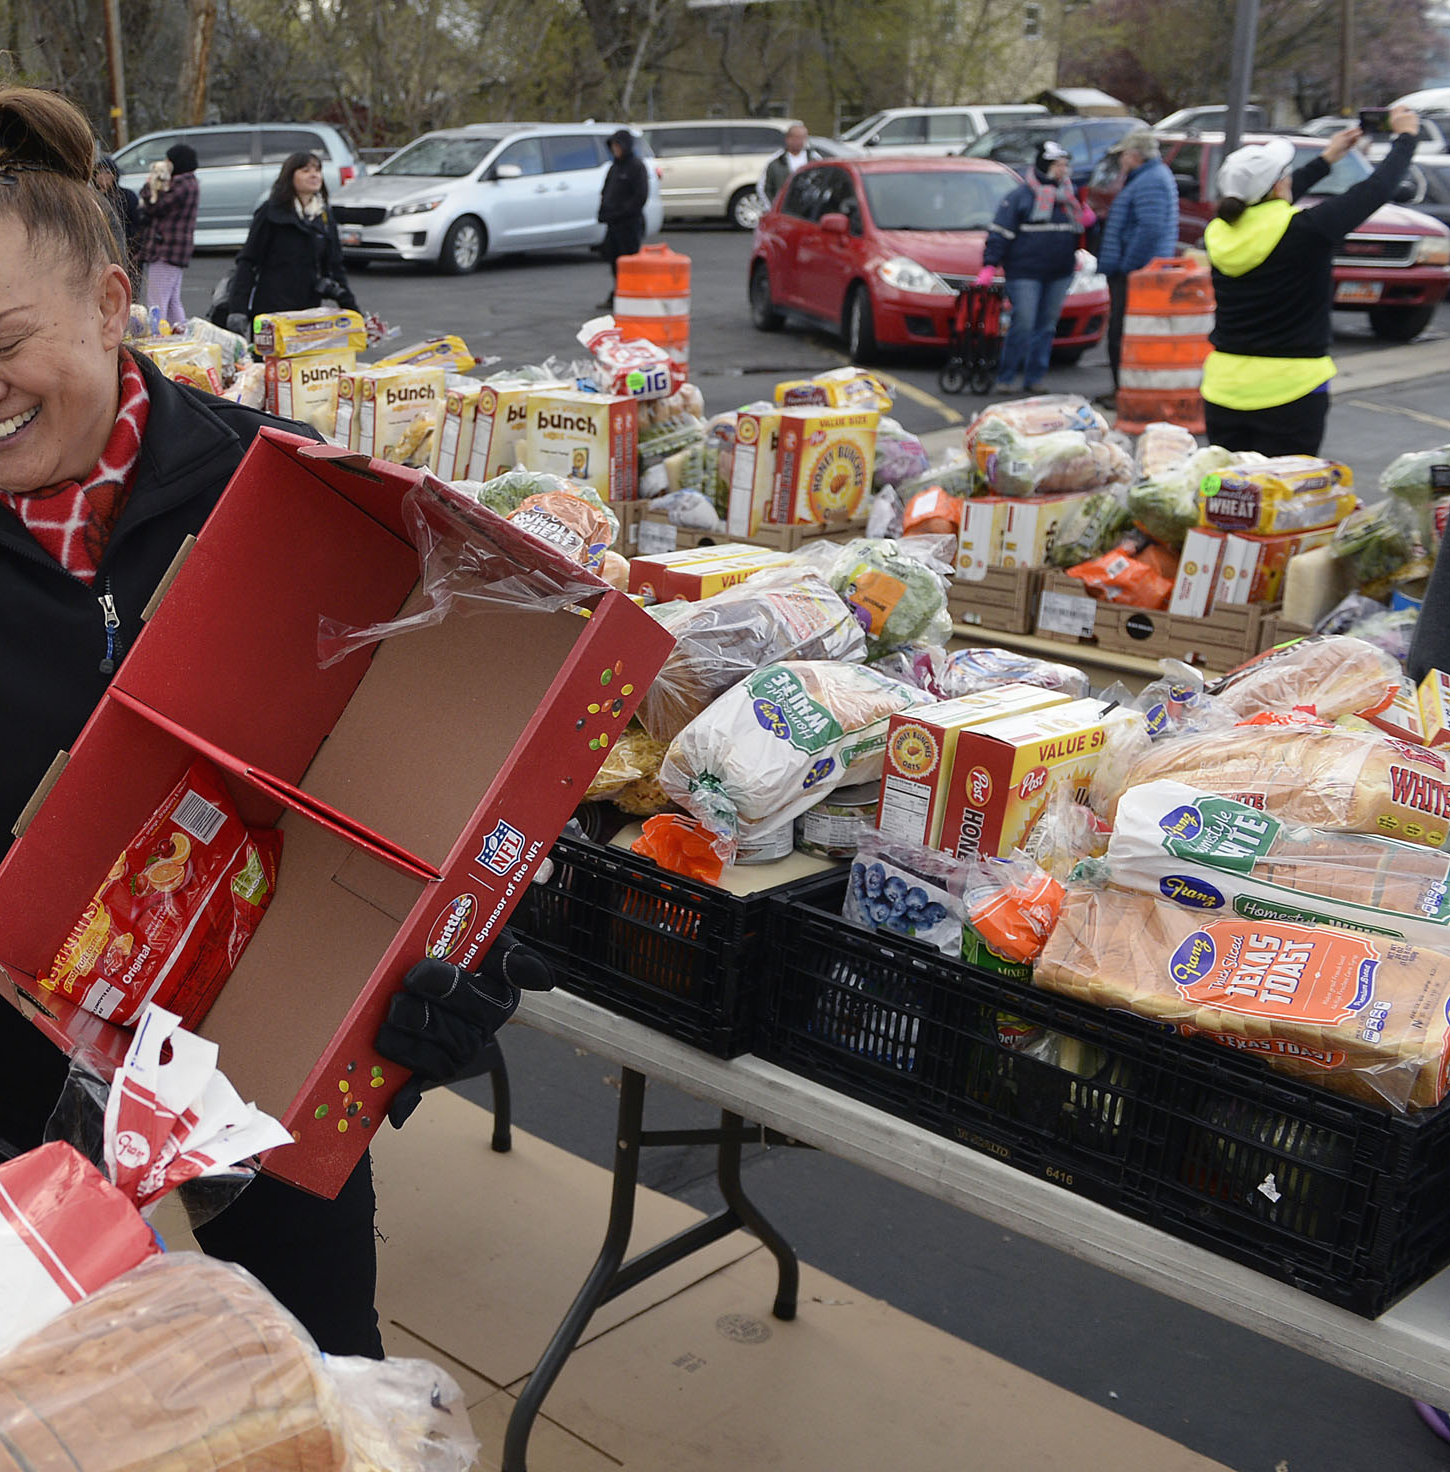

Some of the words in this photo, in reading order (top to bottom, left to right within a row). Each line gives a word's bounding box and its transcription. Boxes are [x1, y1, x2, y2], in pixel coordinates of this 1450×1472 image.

[301, 365, 347, 385] bunch
[386, 384, 436, 406] bunch
[537, 411, 598, 437] bunch
[1208, 497, 1256, 518] WHEAT
[510, 518, 573, 546] WHEAT
[515, 510, 577, 541] WHOLE
[770, 671, 830, 735] WHITE
[895, 732, 912, 752] HONEY
[912, 731, 933, 760] BUNCHES
[1038, 734, 1086, 762] VALUE
[1090, 730, 1106, 748] SI
[901, 760, 922, 771] OATS
[971, 770, 990, 803] Post
[1020, 770, 1047, 798] Post
[1389, 765, 1450, 819] WHITE
[955, 807, 985, 862] HONE
[1190, 810, 1234, 853] omestyle
[491, 836, 522, 871] NFL
[458, 942, 480, 970] icial
[475, 896, 508, 943] Sponsor
[505, 881, 517, 897] of
[512, 863, 529, 883] the
[524, 840, 545, 862] NFL
[1167, 878, 1219, 907] Franz
[431, 896, 473, 959] Skittles
[1244, 902, 1323, 928] Homestyl
[121, 944, 152, 986] Original
[997, 966, 1029, 978] MIXED
[1172, 937, 1212, 981] Franz
[1207, 968, 1230, 991] Thick
[1223, 933, 1246, 972] Sliced
[1224, 932, 1284, 999] TEXAS
[1258, 939, 1316, 1005] TOAST
[1359, 963, 1373, 983] Bread
[1353, 978, 1370, 1008] Premium
[1215, 1033, 1272, 1052] TEXAS
[1275, 1040, 1334, 1063] TOAST
[1045, 1166, 1074, 1186] 6416
